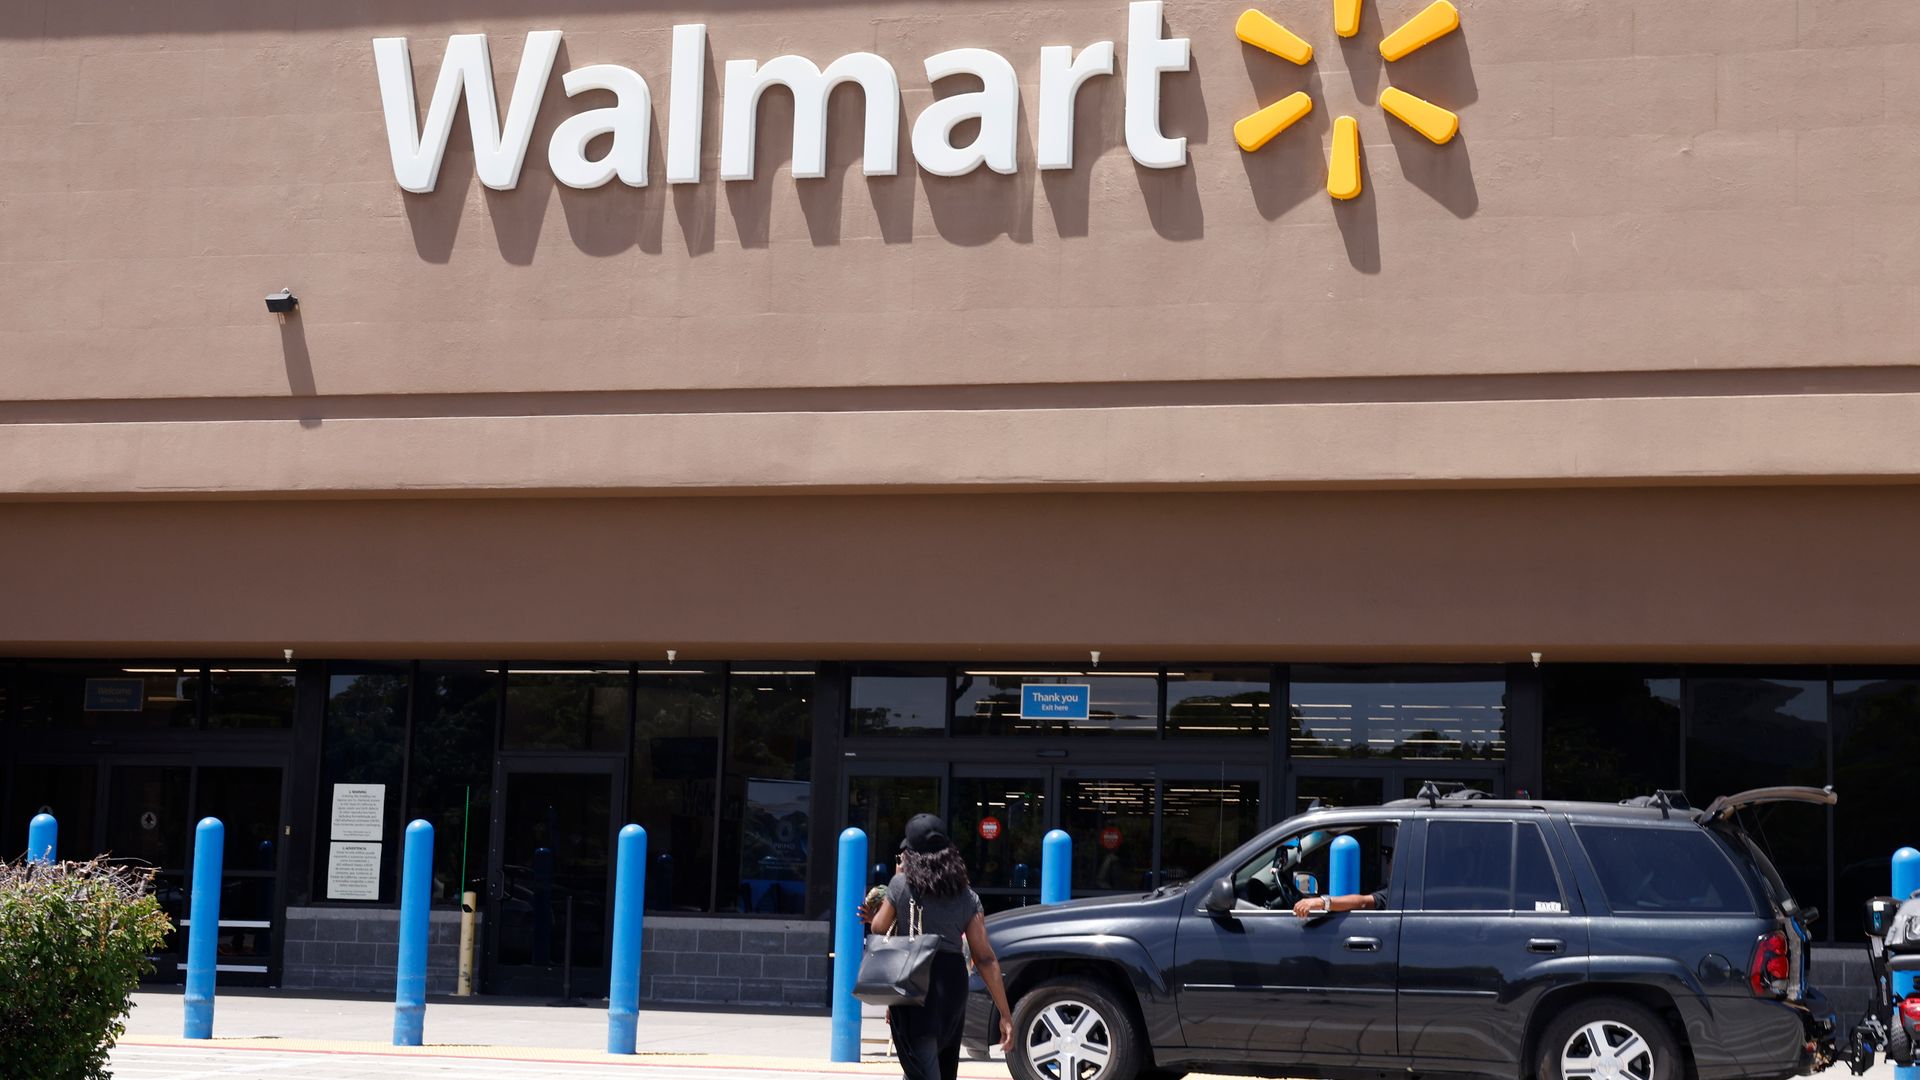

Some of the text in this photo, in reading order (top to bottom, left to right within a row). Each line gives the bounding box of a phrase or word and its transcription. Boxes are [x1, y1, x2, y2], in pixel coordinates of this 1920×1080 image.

[372, 0, 1190, 193] Walmart
[1032, 692, 1079, 704] Thank you
